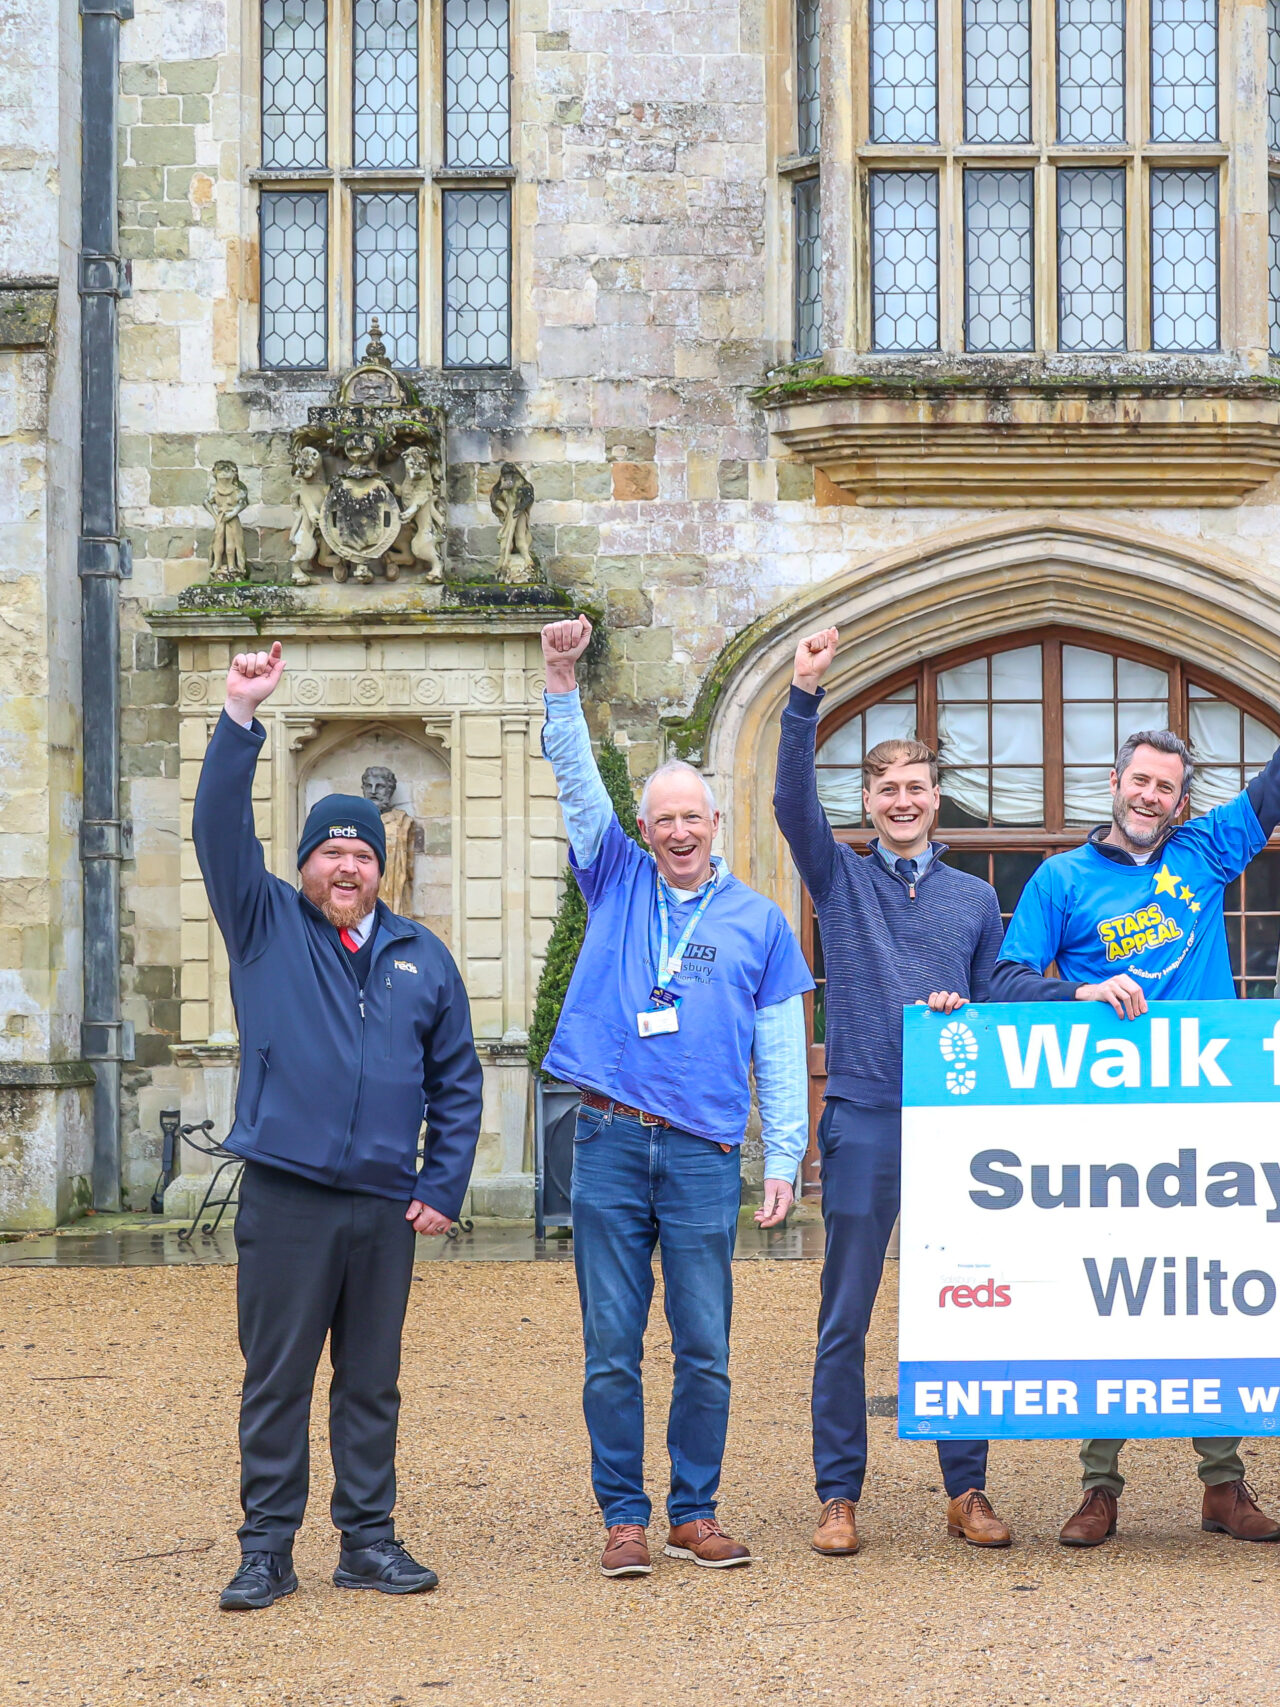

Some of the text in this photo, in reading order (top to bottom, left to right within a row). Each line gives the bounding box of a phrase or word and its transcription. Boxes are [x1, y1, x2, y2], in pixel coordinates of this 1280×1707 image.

[329, 826, 358, 838] reds
[1099, 905, 1163, 942] STARS
[1108, 920, 1181, 960] APPEAL
[997, 1017, 1232, 1089] Walk
[939, 1278, 1012, 1308] reds
[914, 1380, 1078, 1416] ENTER
[1096, 1378, 1221, 1415] FREE
